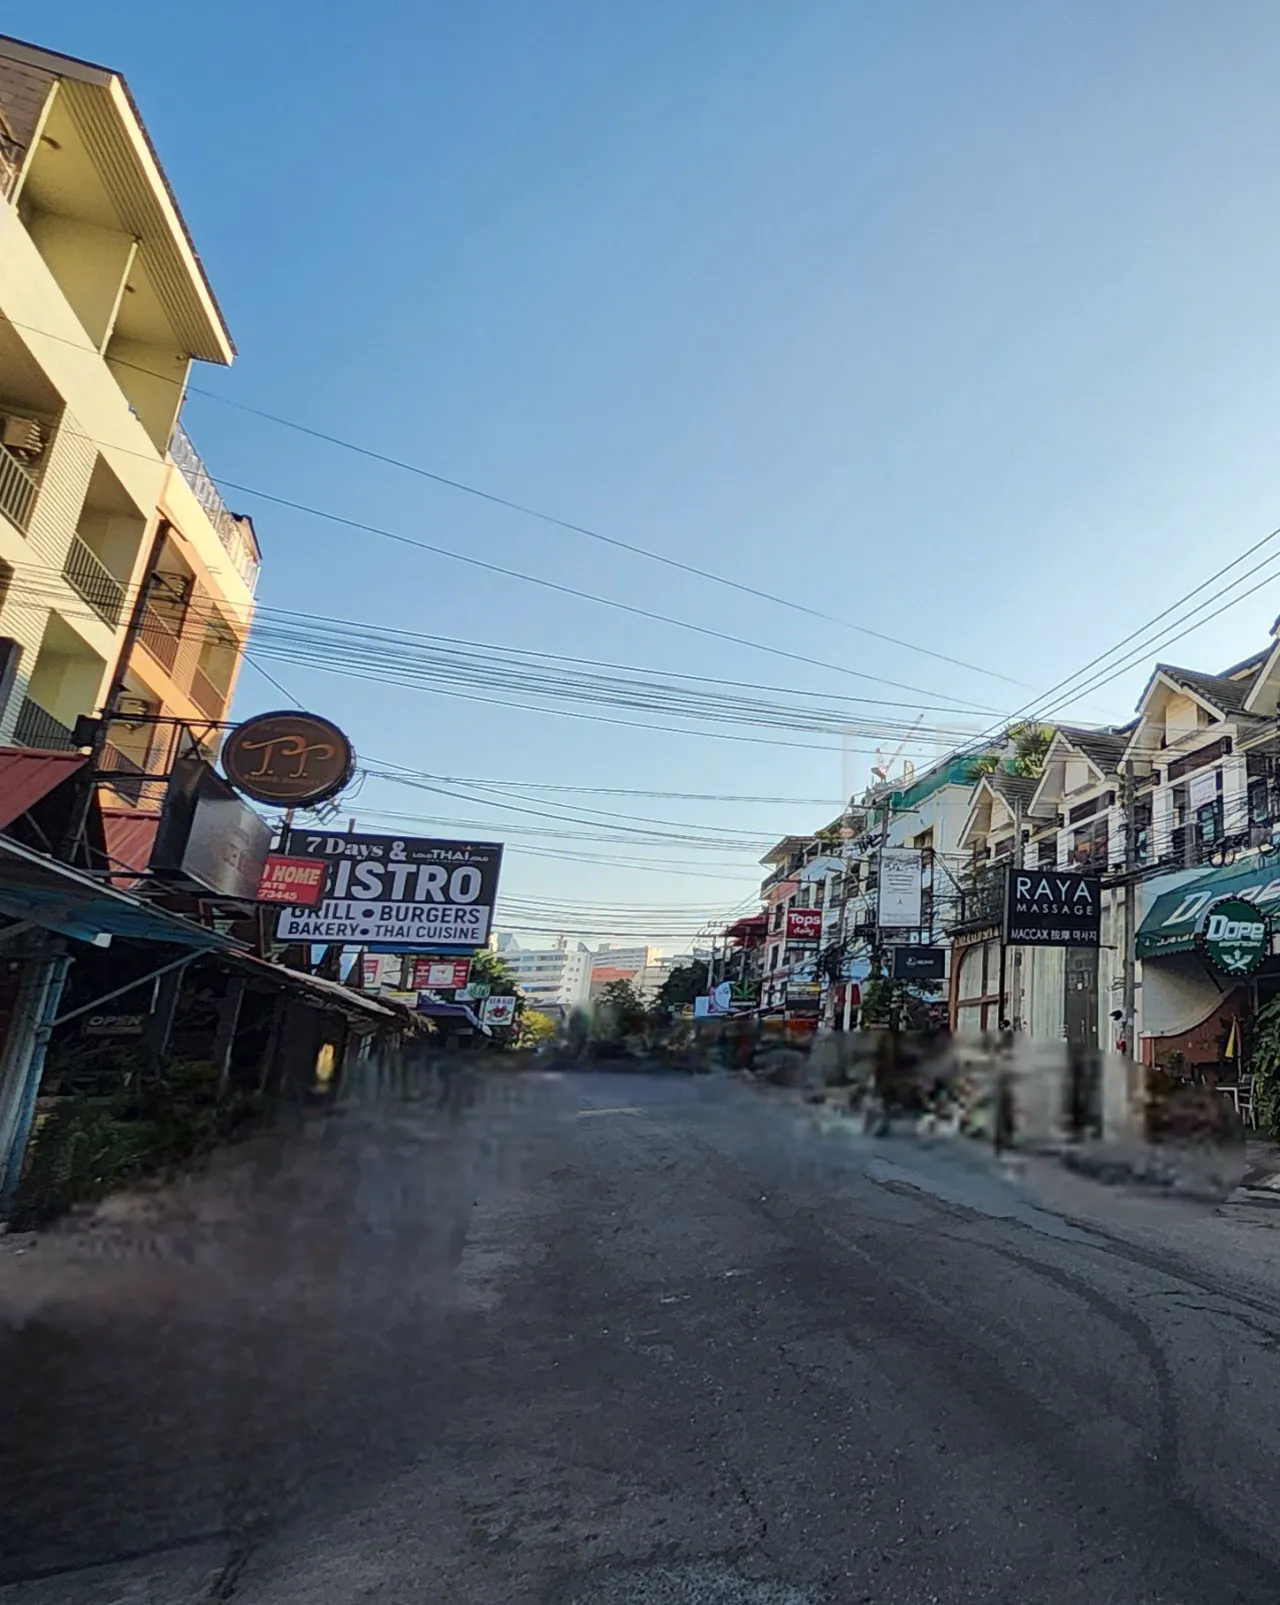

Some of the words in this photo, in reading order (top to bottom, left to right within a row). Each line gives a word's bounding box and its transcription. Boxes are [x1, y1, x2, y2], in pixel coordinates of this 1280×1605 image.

[306, 837, 321, 853] 7
[325, 837, 384, 860] Days
[389, 841, 407, 861] &
[272, 865, 321, 885] HOME
[324, 859, 482, 904] ISTRO
[1017, 877, 1092, 903] RAYA
[291, 902, 356, 921] GRILL
[380, 905, 480, 924] BURGERS
[790, 913, 820, 926] Tops
[1016, 903, 1093, 916] MASSAGE
[288, 920, 360, 936] BAKERY
[374, 924, 412, 938] THAI
[416, 925, 480, 940] CUISINE
